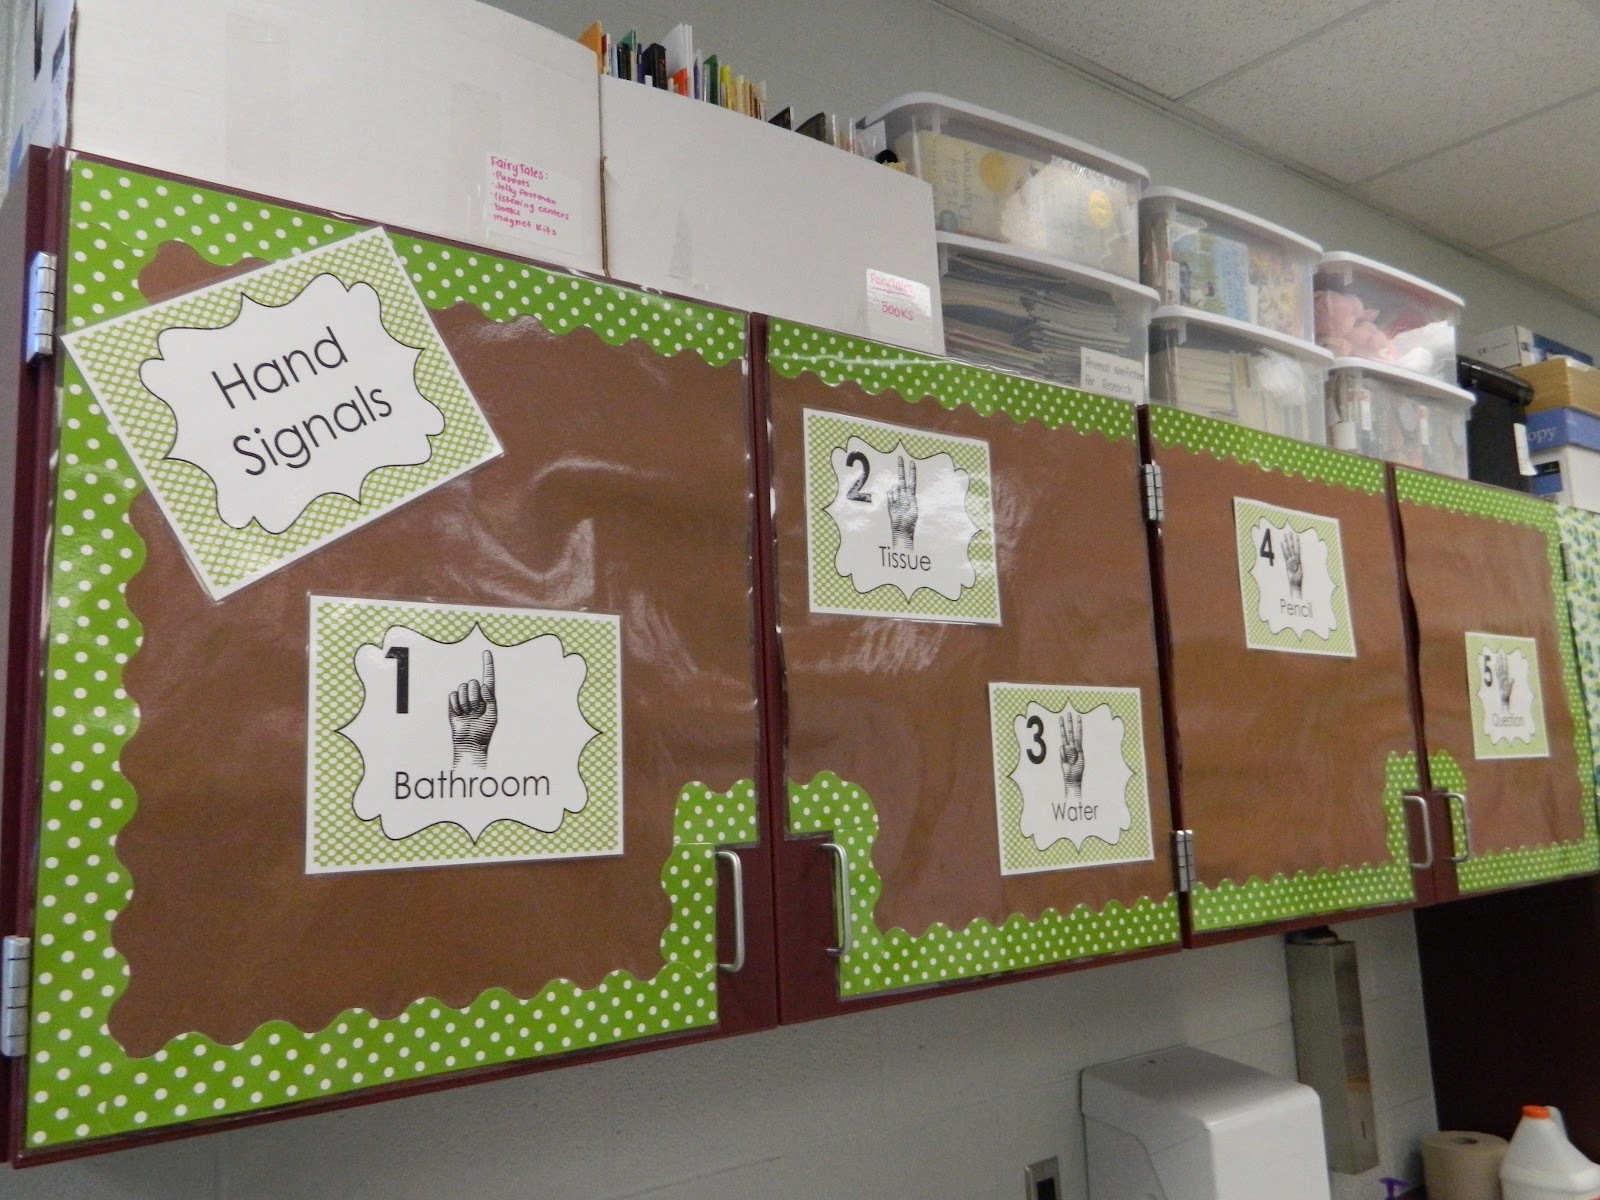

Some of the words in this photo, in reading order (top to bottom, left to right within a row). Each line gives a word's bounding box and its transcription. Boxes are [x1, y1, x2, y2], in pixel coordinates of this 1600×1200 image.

[881, 300, 914, 321] BOOKS
[211, 325, 348, 410] Hand
[233, 385, 392, 476] Signals
[1526, 426, 1557, 442] opy
[846, 451, 872, 503] 2
[879, 545, 931, 571] Tissue
[1260, 528, 1275, 567] 4
[1280, 598, 1313, 618] Pencil
[385, 646, 409, 714] 1
[1484, 655, 1493, 688] 5
[1026, 715, 1047, 765] 3
[395, 770, 550, 800] Bathroom
[1051, 801, 1099, 822] Water
